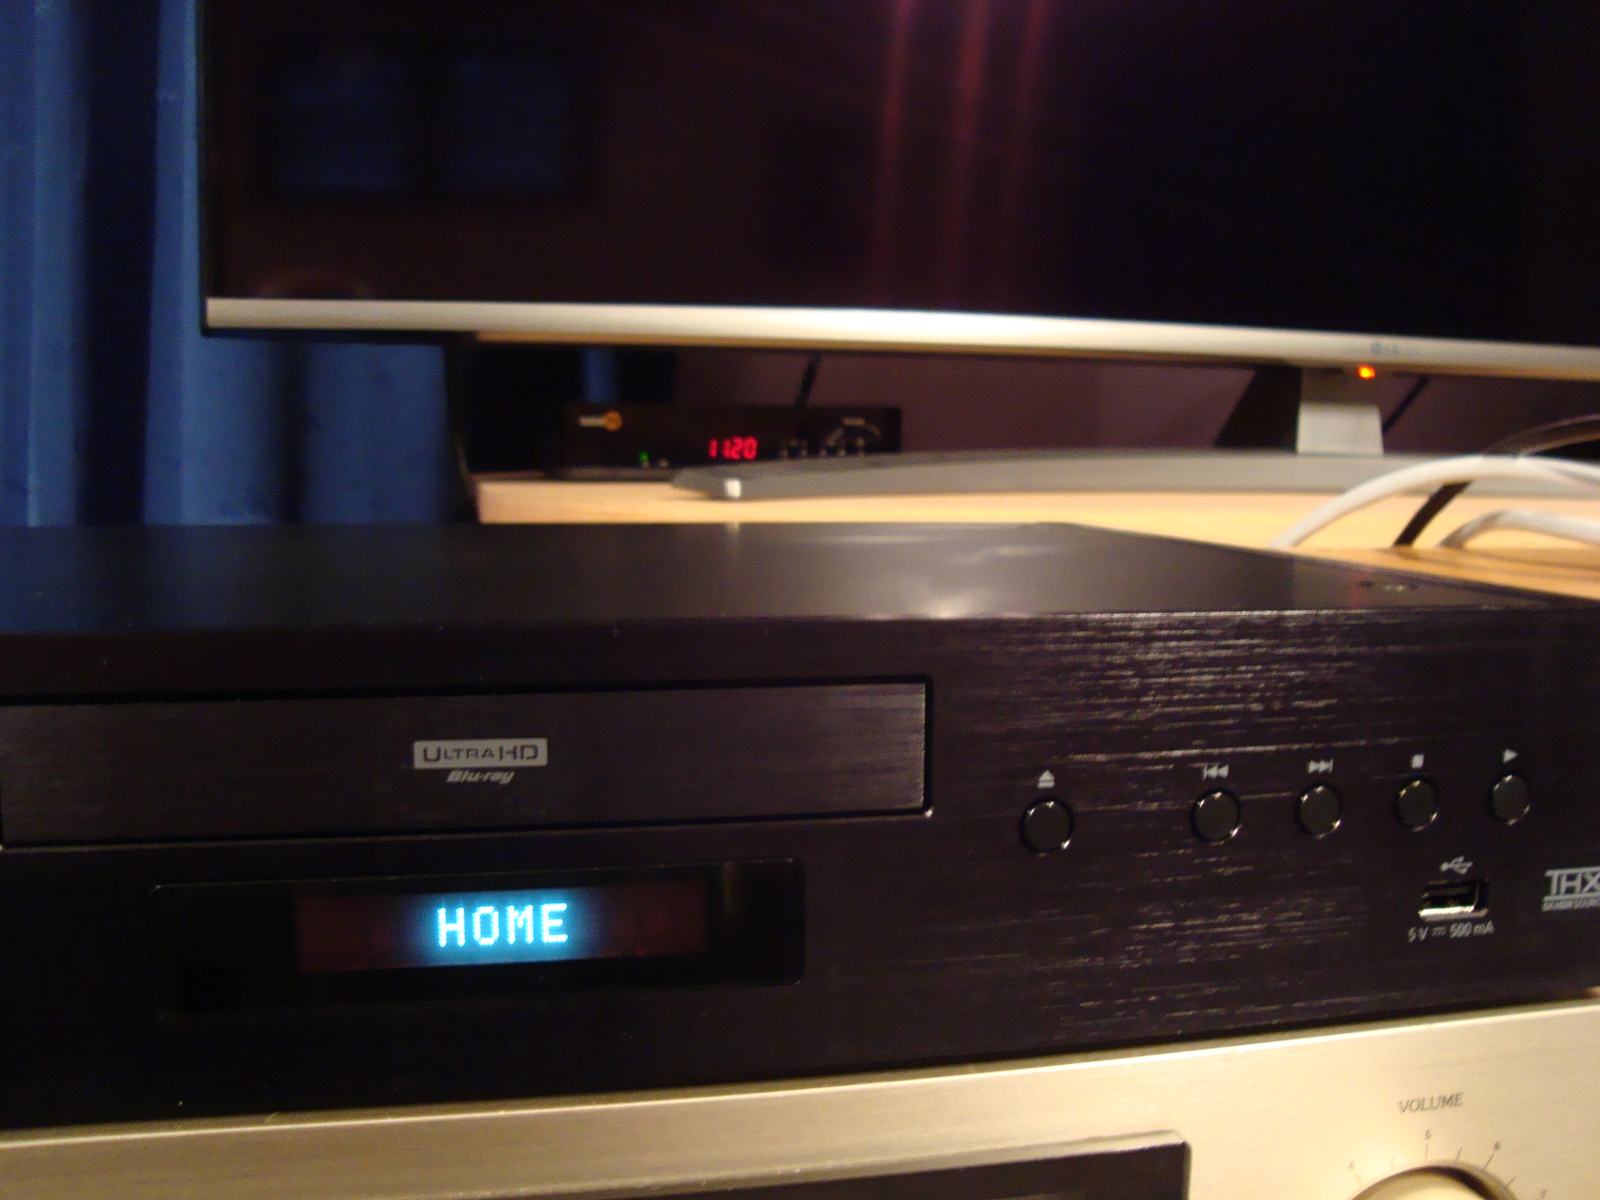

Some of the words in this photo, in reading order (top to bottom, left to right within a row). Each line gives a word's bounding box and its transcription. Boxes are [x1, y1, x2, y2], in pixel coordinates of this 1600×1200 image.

[708, 436, 758, 460] 1120
[1544, 866, 1600, 898] THX
[436, 902, 569, 948] HOME
[1449, 921, 1473, 939] 500
[1399, 1092, 1464, 1114] VOLUME
